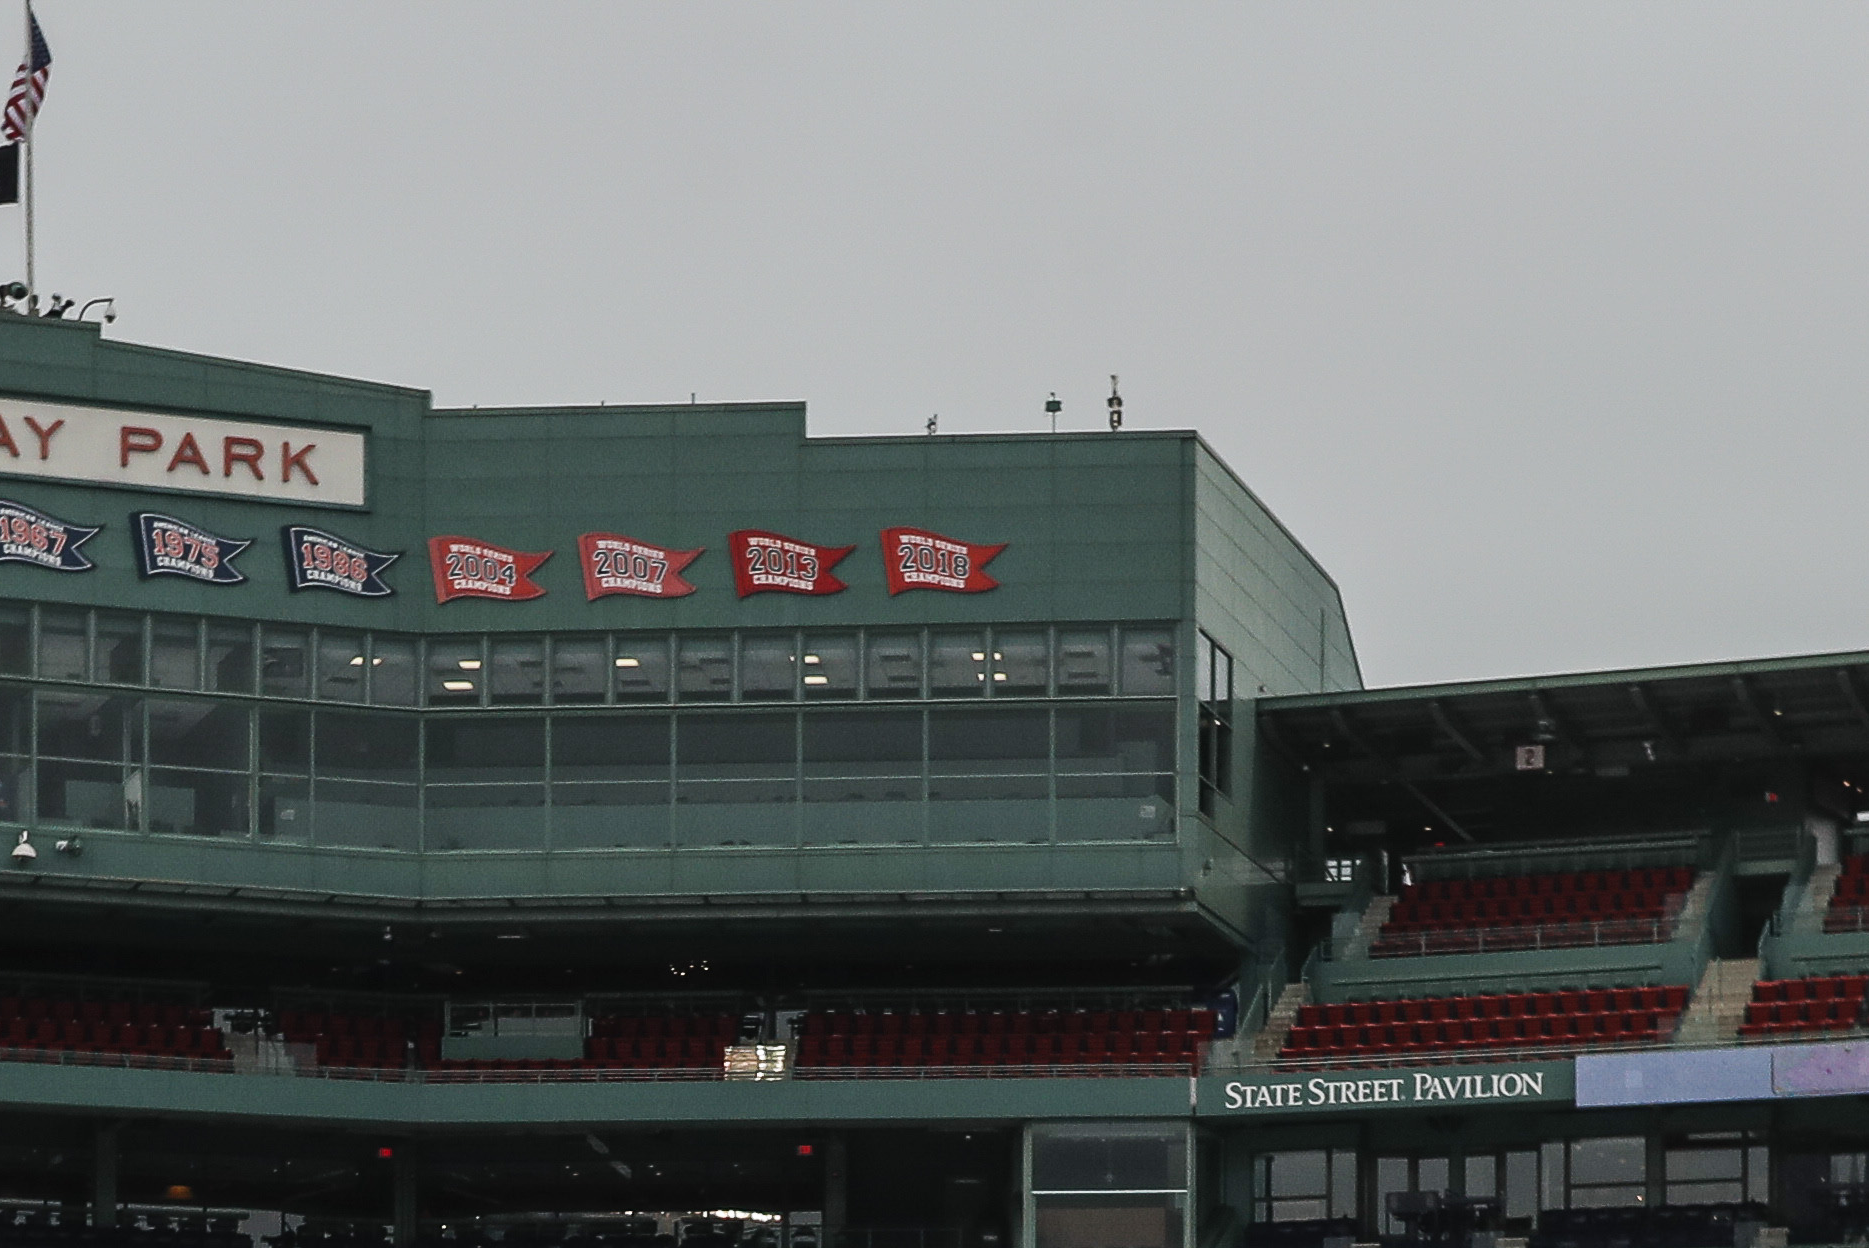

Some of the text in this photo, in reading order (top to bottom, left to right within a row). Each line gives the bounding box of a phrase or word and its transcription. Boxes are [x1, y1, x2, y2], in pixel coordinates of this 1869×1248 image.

[119, 426, 319, 486] PARK
[152, 529, 219, 569] 1975
[301, 543, 368, 583] 1986
[593, 550, 668, 583] 2007
[746, 546, 819, 581] 2013
[897, 544, 970, 579] 2018
[446, 553, 516, 587] 2004
[1225, 1072, 1544, 1109] STATE STREET PAVILION
